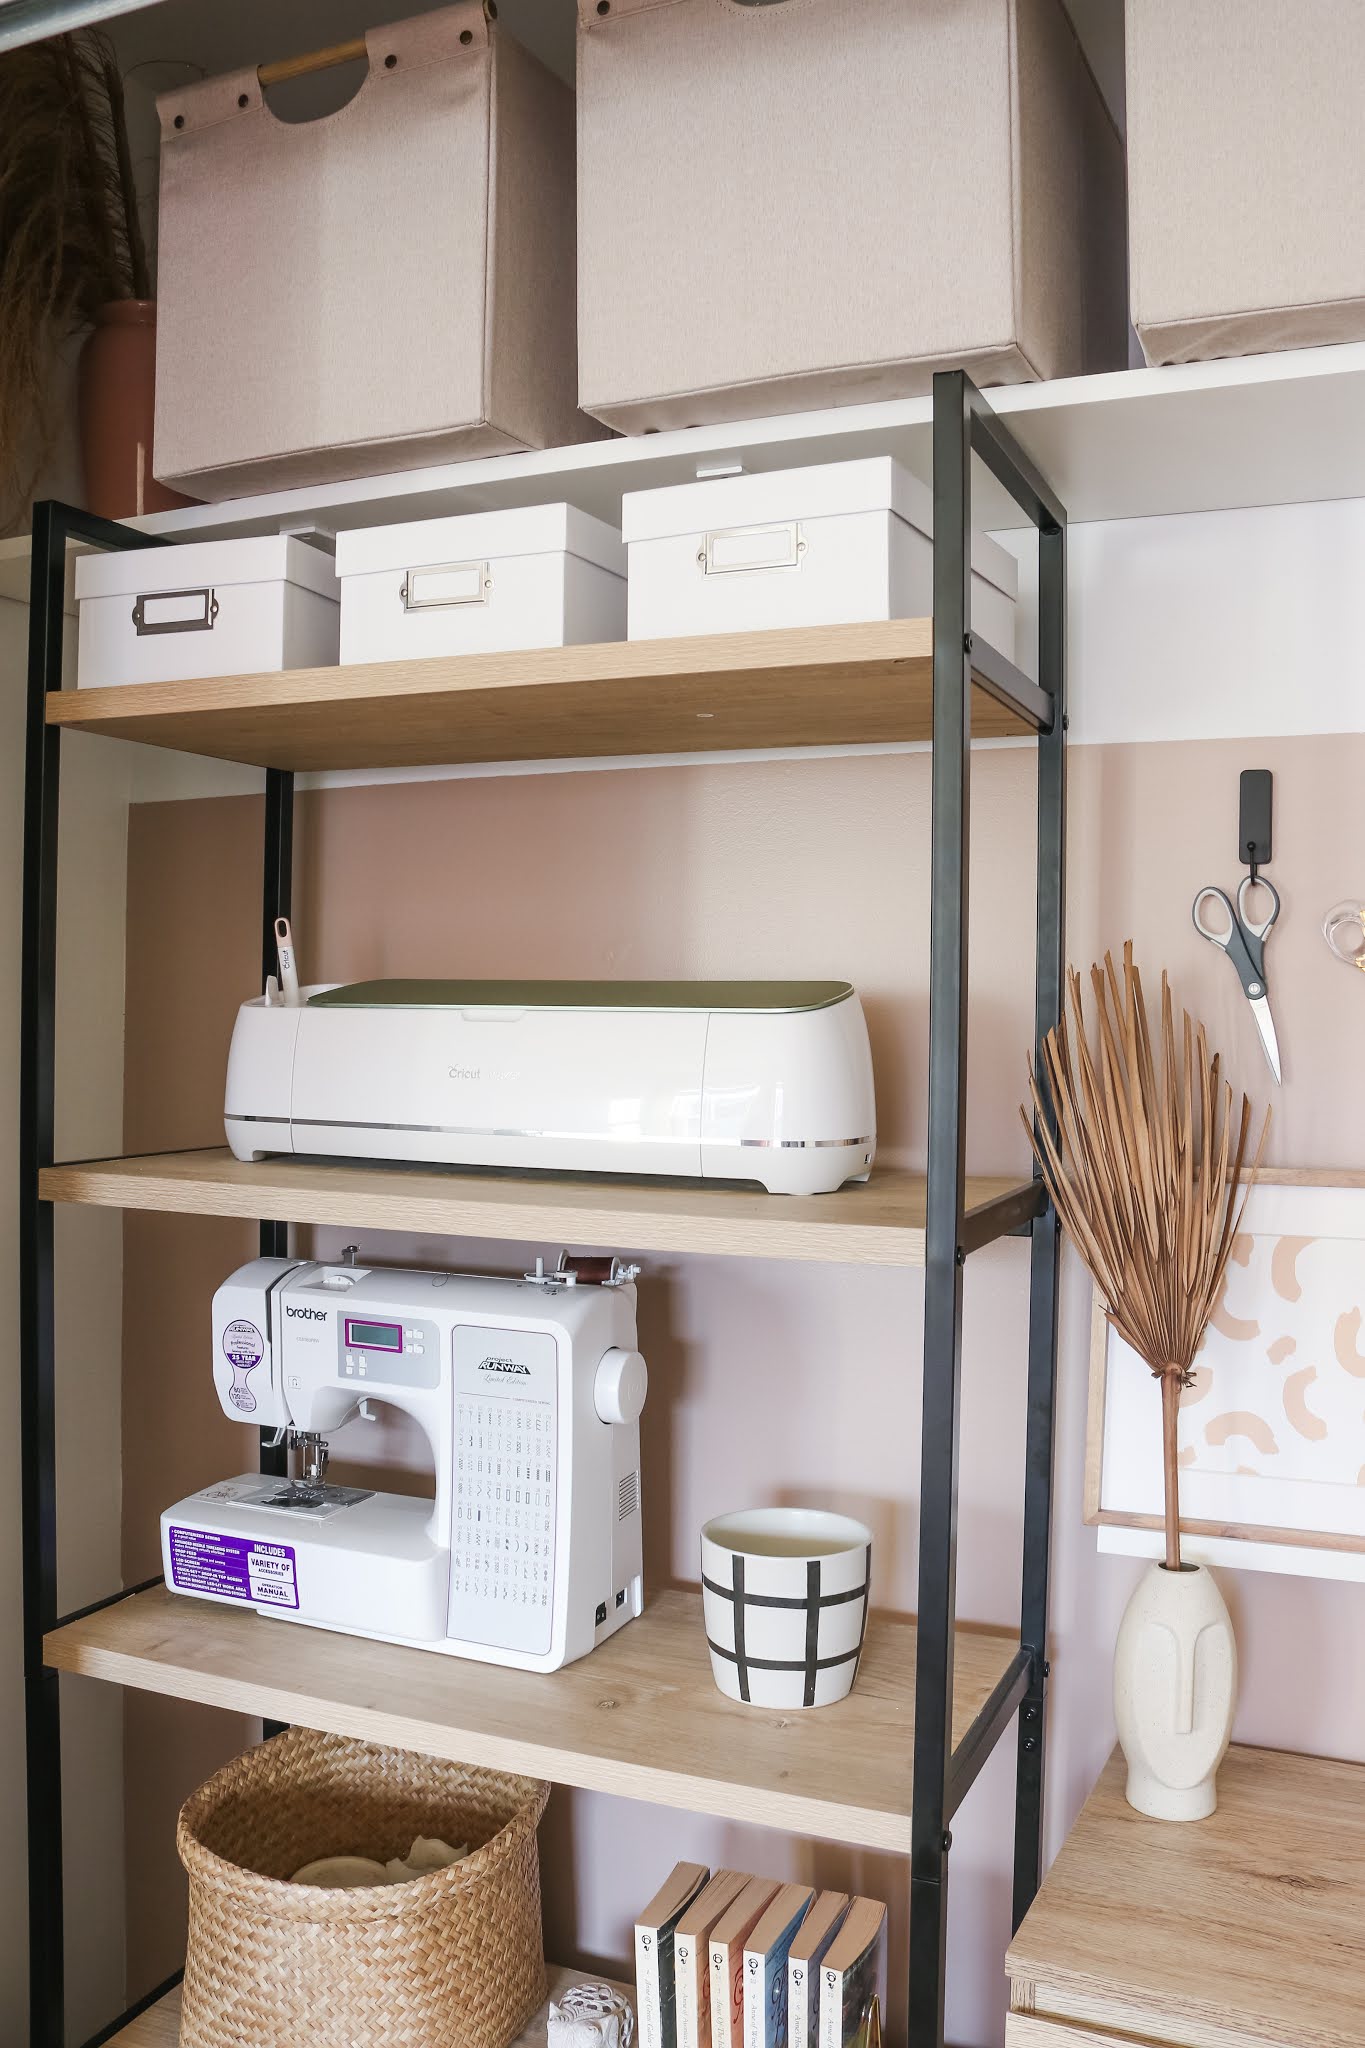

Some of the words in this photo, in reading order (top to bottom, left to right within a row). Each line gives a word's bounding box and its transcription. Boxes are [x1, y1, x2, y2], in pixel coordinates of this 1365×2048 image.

[448, 1065, 480, 1079] Cricut
[286, 1305, 327, 1321] brother
[479, 1361, 529, 1374] RUNWAY
[254, 1544, 286, 1557] INCLUDES
[251, 1558, 279, 1569] VARIETY
[281, 1563, 290, 1571] OF
[257, 1587, 288, 1597] MANUAL
